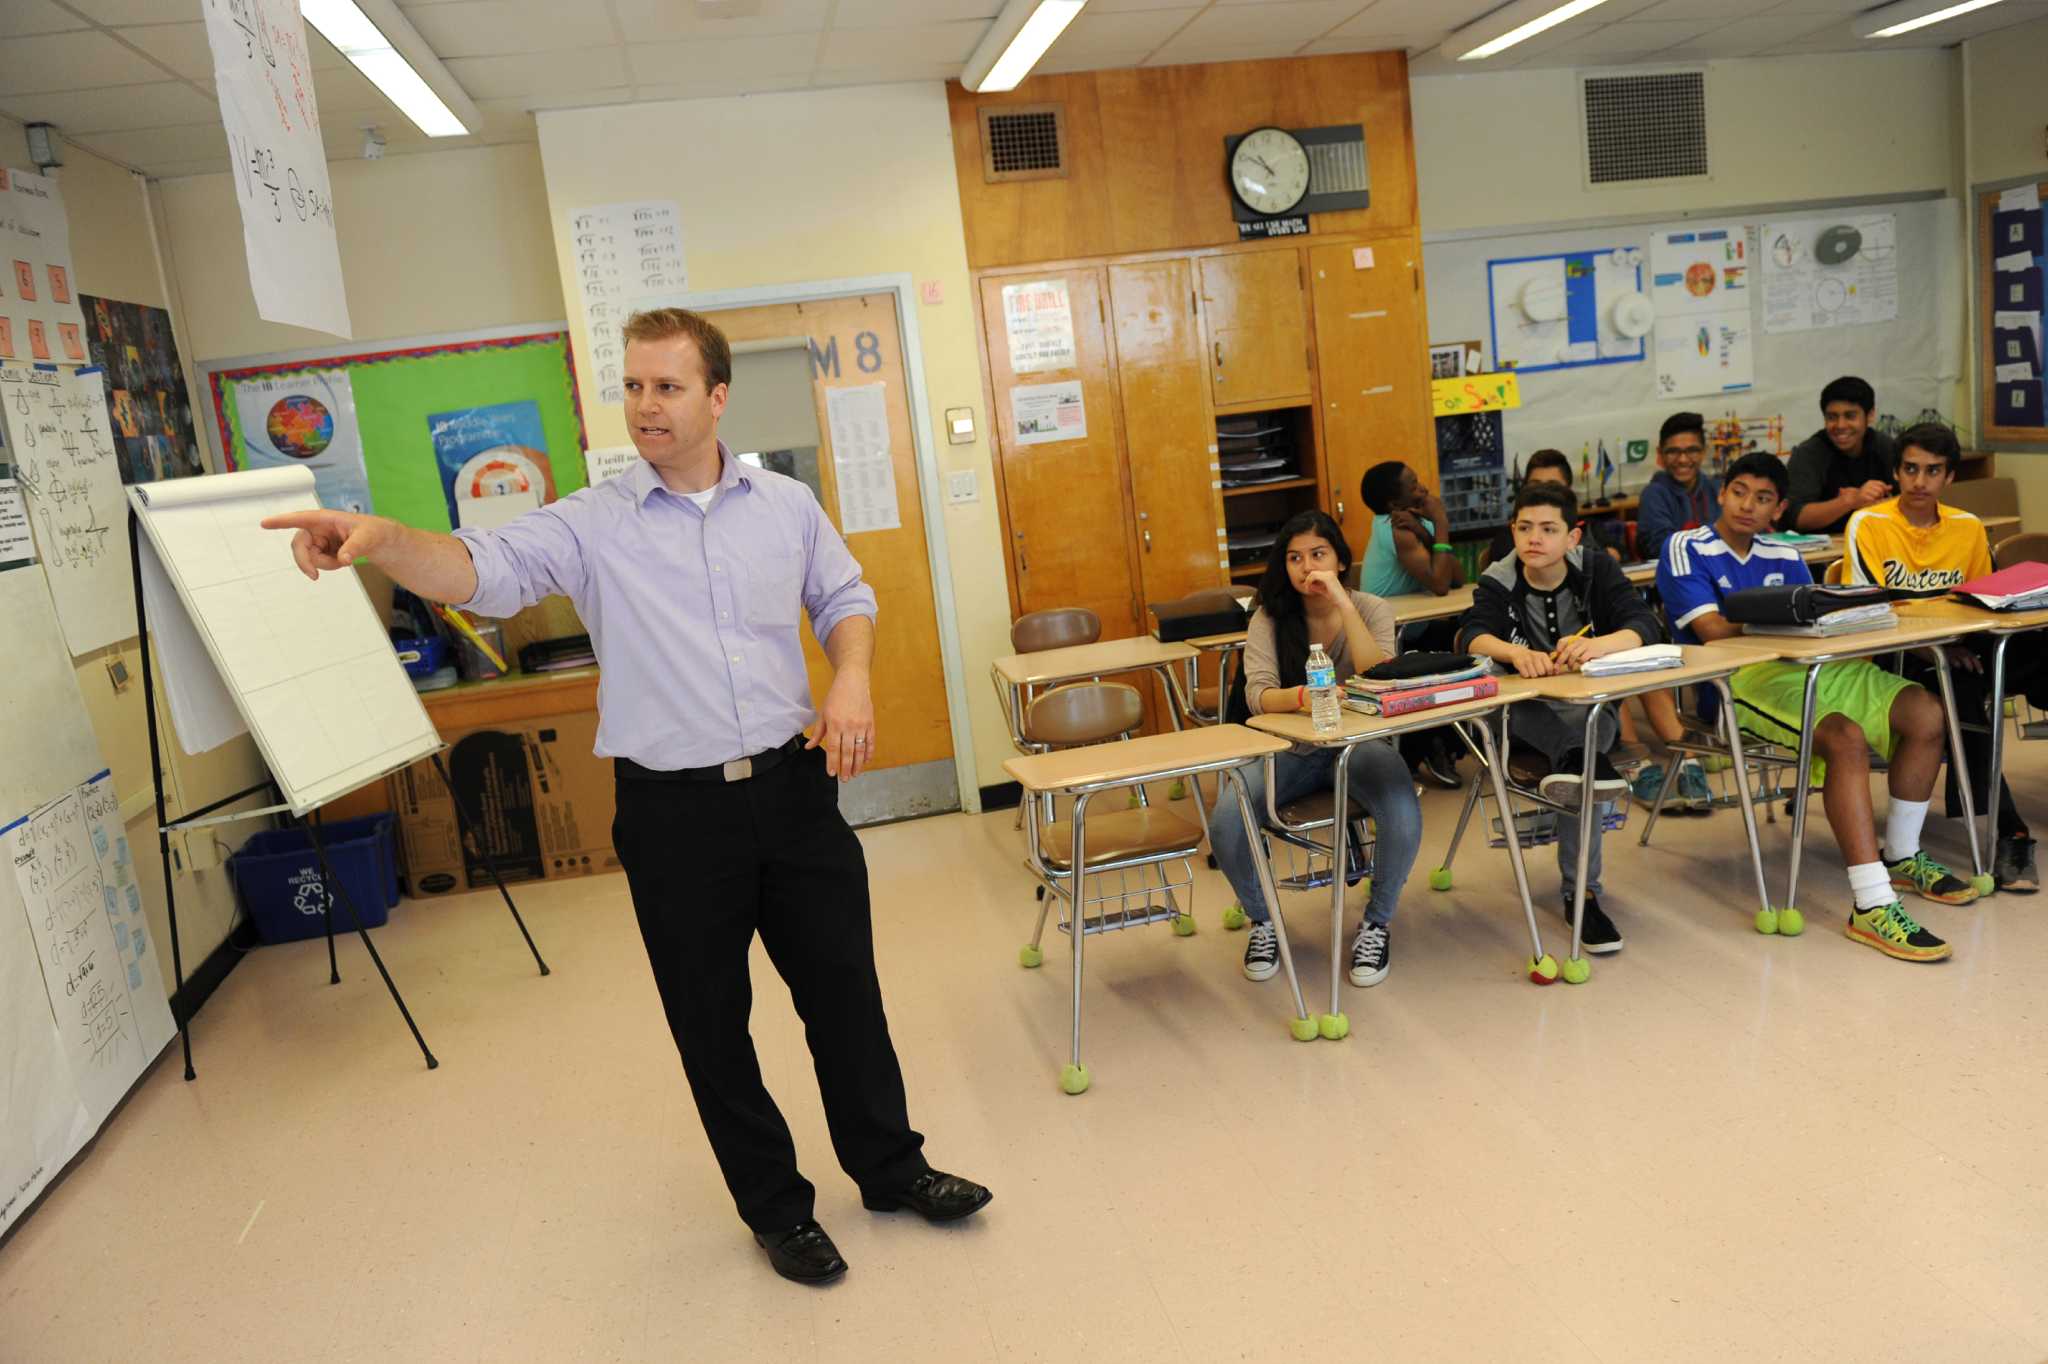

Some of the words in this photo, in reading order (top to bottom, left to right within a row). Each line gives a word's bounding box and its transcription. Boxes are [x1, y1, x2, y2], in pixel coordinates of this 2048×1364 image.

[808, 335, 841, 380] M
[855, 331, 882, 374] 8
[604, 454, 624, 465] will
[602, 466, 623, 478] give
[287, 872, 329, 885] RECYCL
